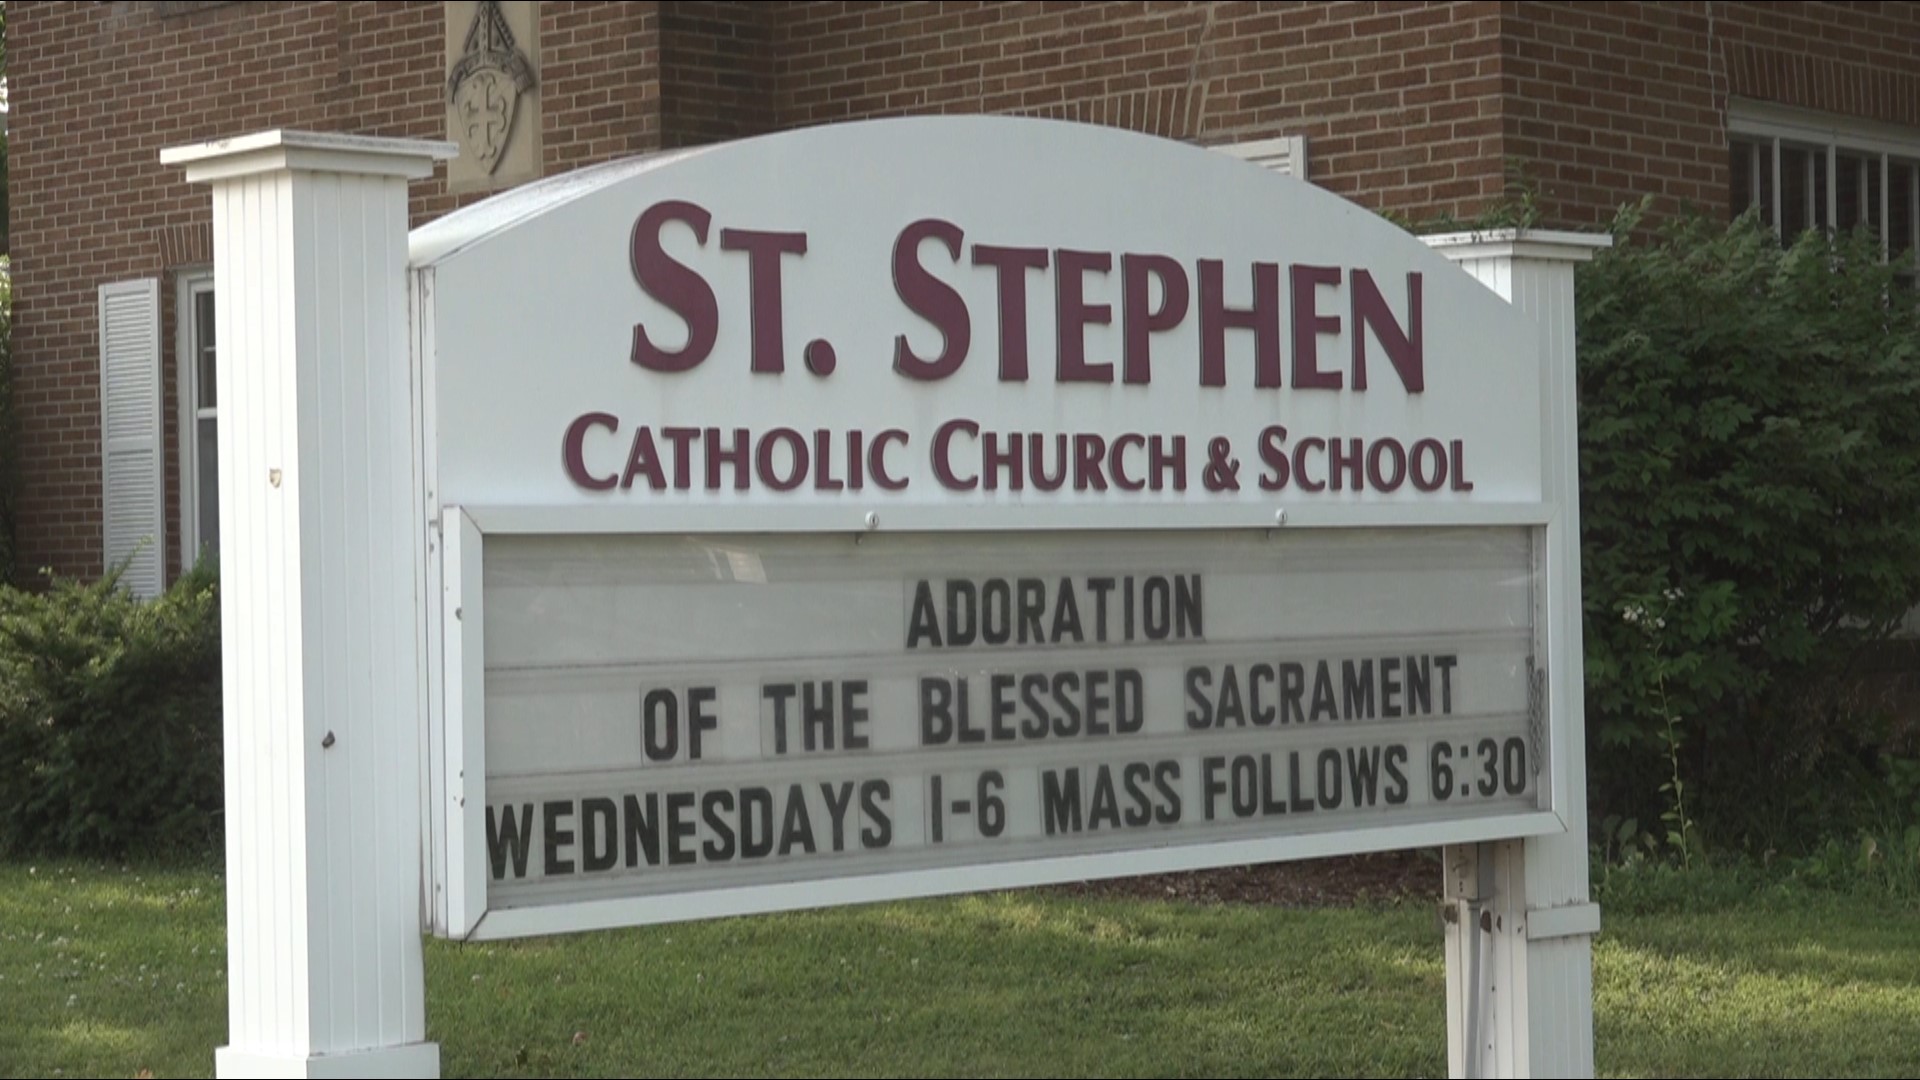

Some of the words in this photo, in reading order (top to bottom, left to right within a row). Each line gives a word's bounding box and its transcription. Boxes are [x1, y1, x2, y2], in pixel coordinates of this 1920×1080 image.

[630, 199, 836, 376] ST.
[892, 218, 1424, 394] STEPHEN
[562, 412, 910, 491] CATHOLIC
[930, 419, 1185, 491] CHURCH
[1202, 436, 1240, 491] &
[1258, 424, 1473, 491] SCHOOL
[908, 574, 1203, 650] ADORATION
[644, 688, 716, 761] OF
[764, 680, 868, 754] THE
[922, 668, 1142, 744] BLESSED
[1185, 655, 1456, 731] SACRAMENT
[487, 779, 891, 879] WEDNESDAYS
[1043, 759, 1180, 834] MASS
[1205, 746, 1407, 820] FOLLOWS
[1432, 737, 1525, 801] 6:30
